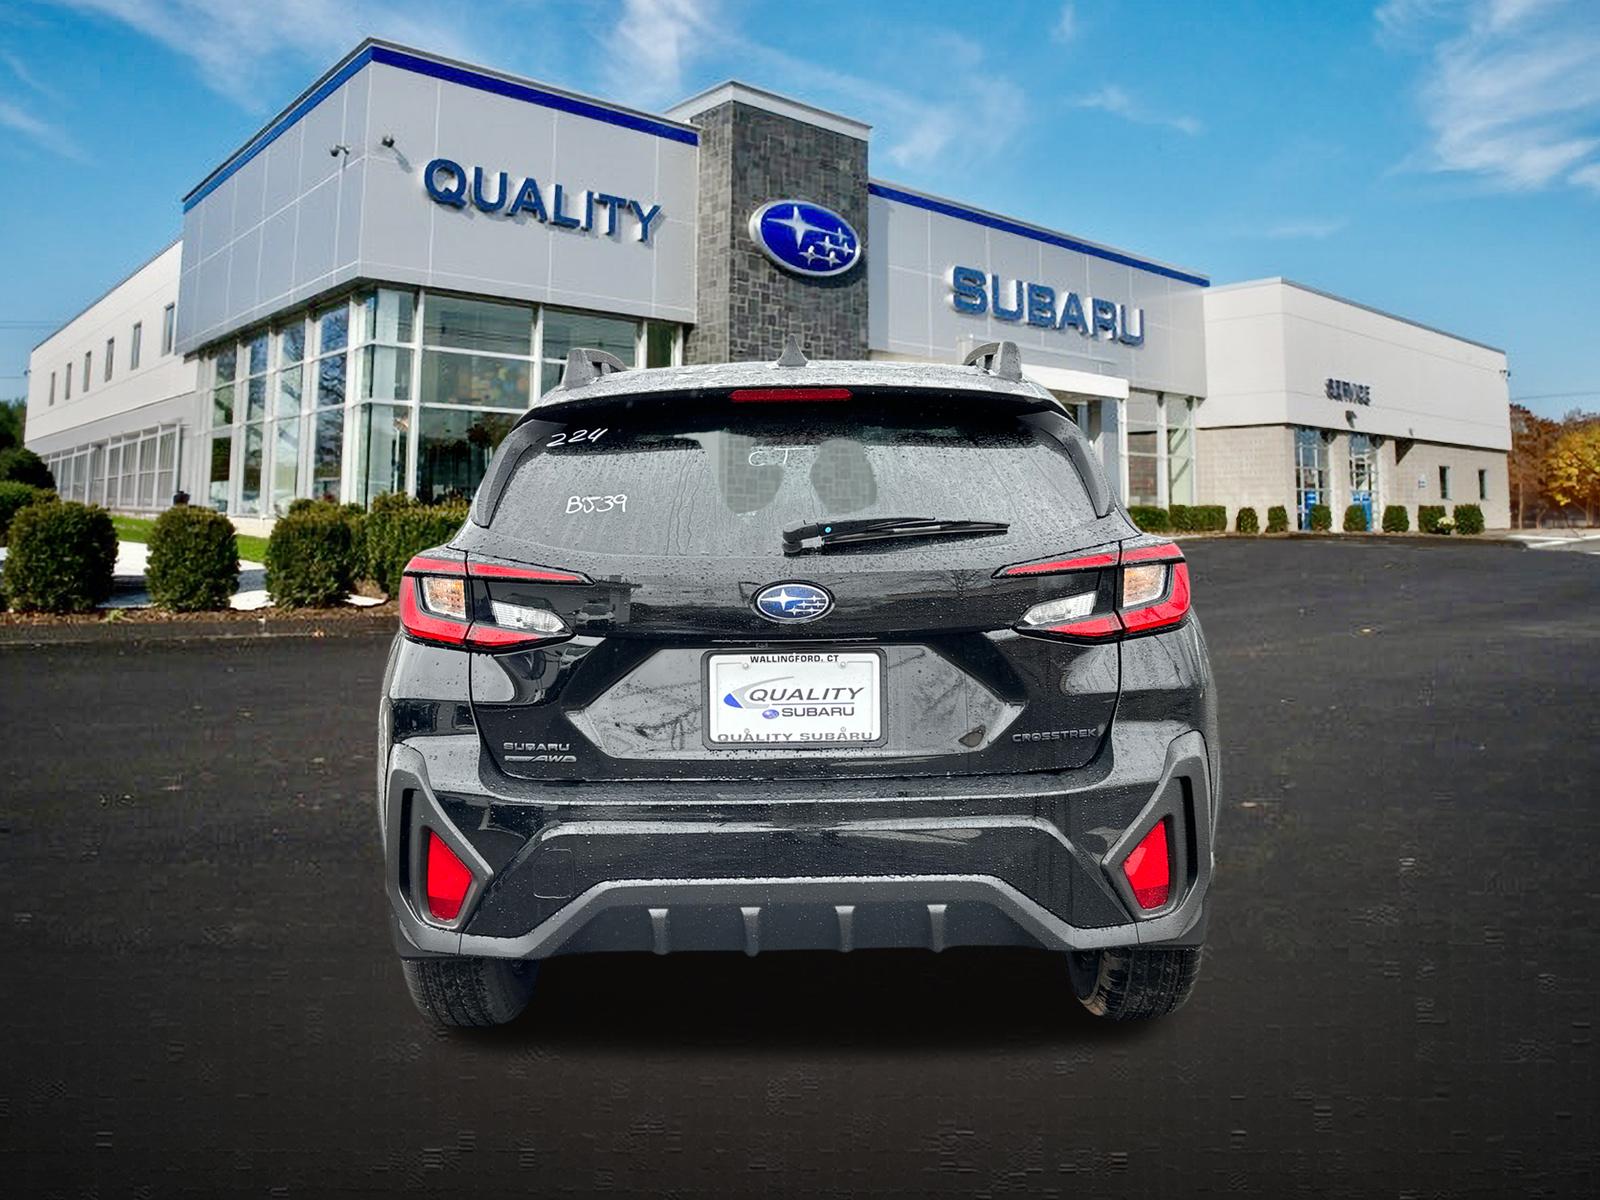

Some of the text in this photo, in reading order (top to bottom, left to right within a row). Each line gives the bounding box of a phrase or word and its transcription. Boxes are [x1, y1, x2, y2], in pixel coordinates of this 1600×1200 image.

[424, 158, 663, 243] QUALITY
[950, 265, 1145, 346] SUBARU
[547, 428, 608, 447] 224
[749, 687, 864, 701] QUALITY
[781, 707, 855, 717] SUBARU
[717, 732, 873, 742] QUALITY SUBARU
[1012, 728, 1097, 742] CROSSTREK
[503, 742, 570, 751] SUBARU
